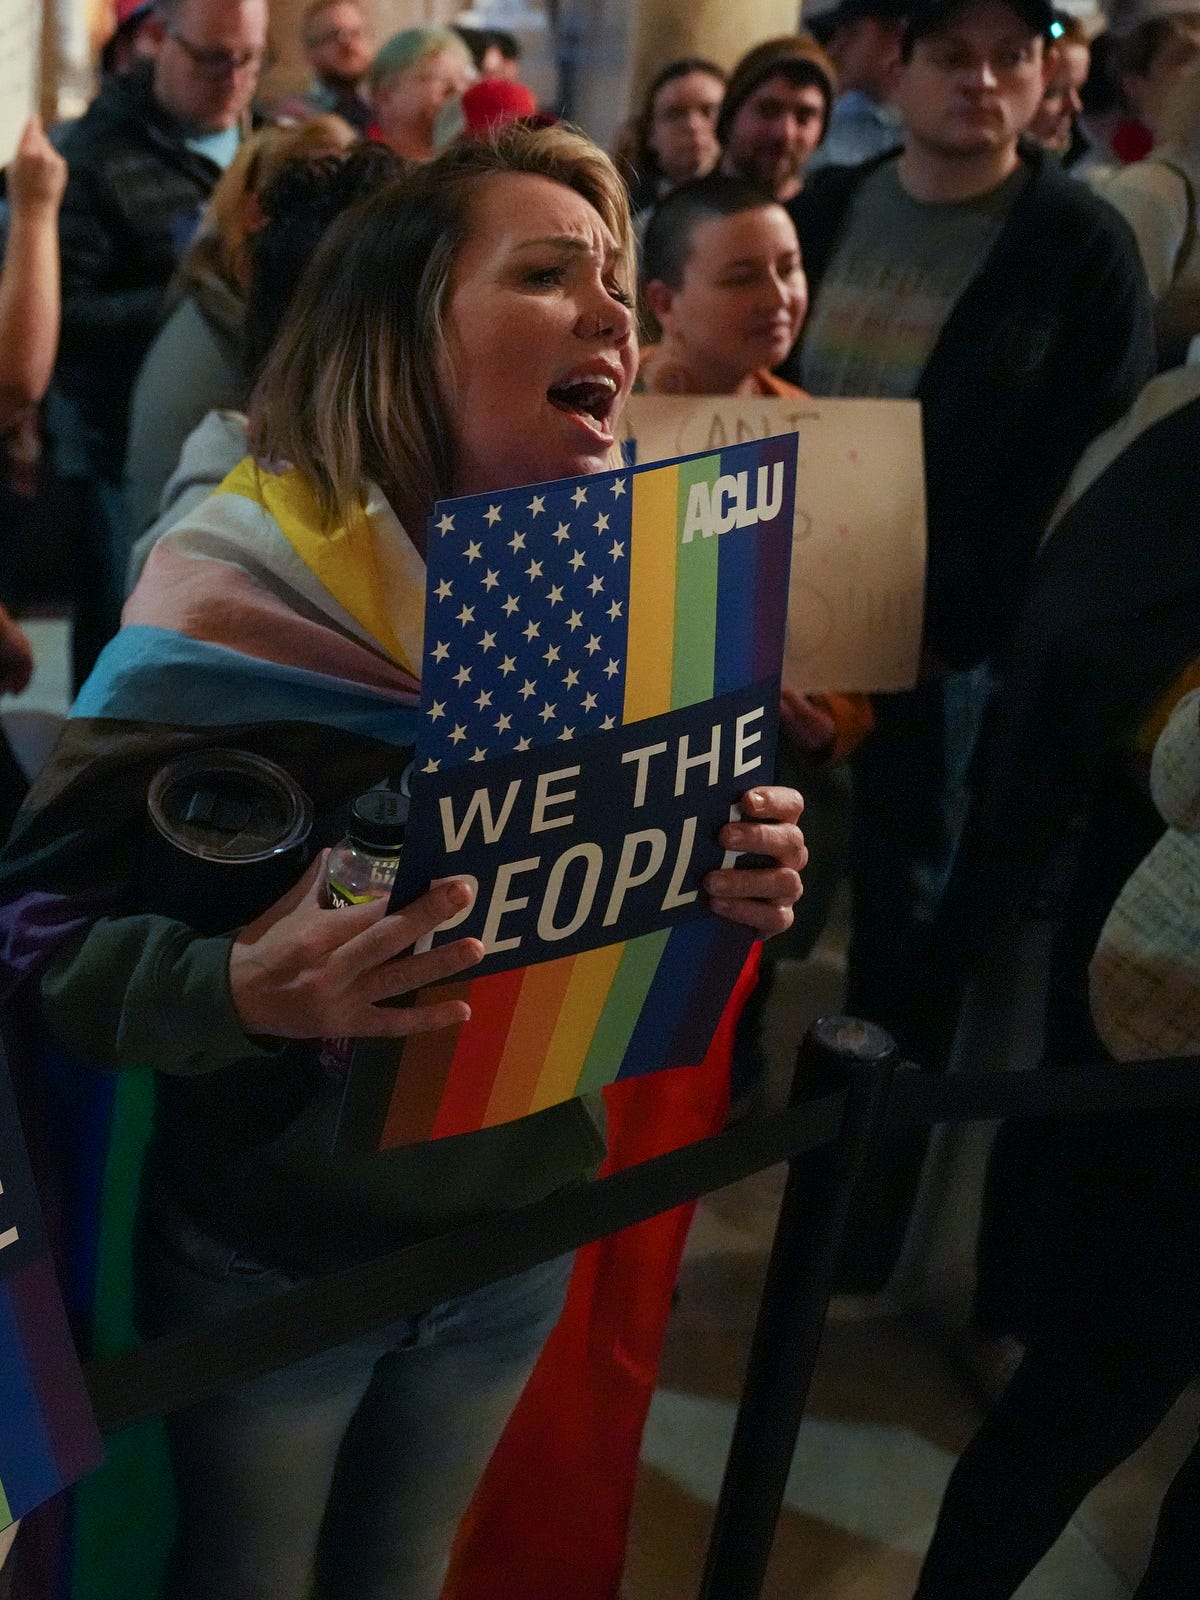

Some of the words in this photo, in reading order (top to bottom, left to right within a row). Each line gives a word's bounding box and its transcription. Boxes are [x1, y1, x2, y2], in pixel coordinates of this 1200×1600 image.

[681, 460, 785, 545] ACLU
[439, 765, 582, 854] WE
[621, 706, 765, 808] THE
